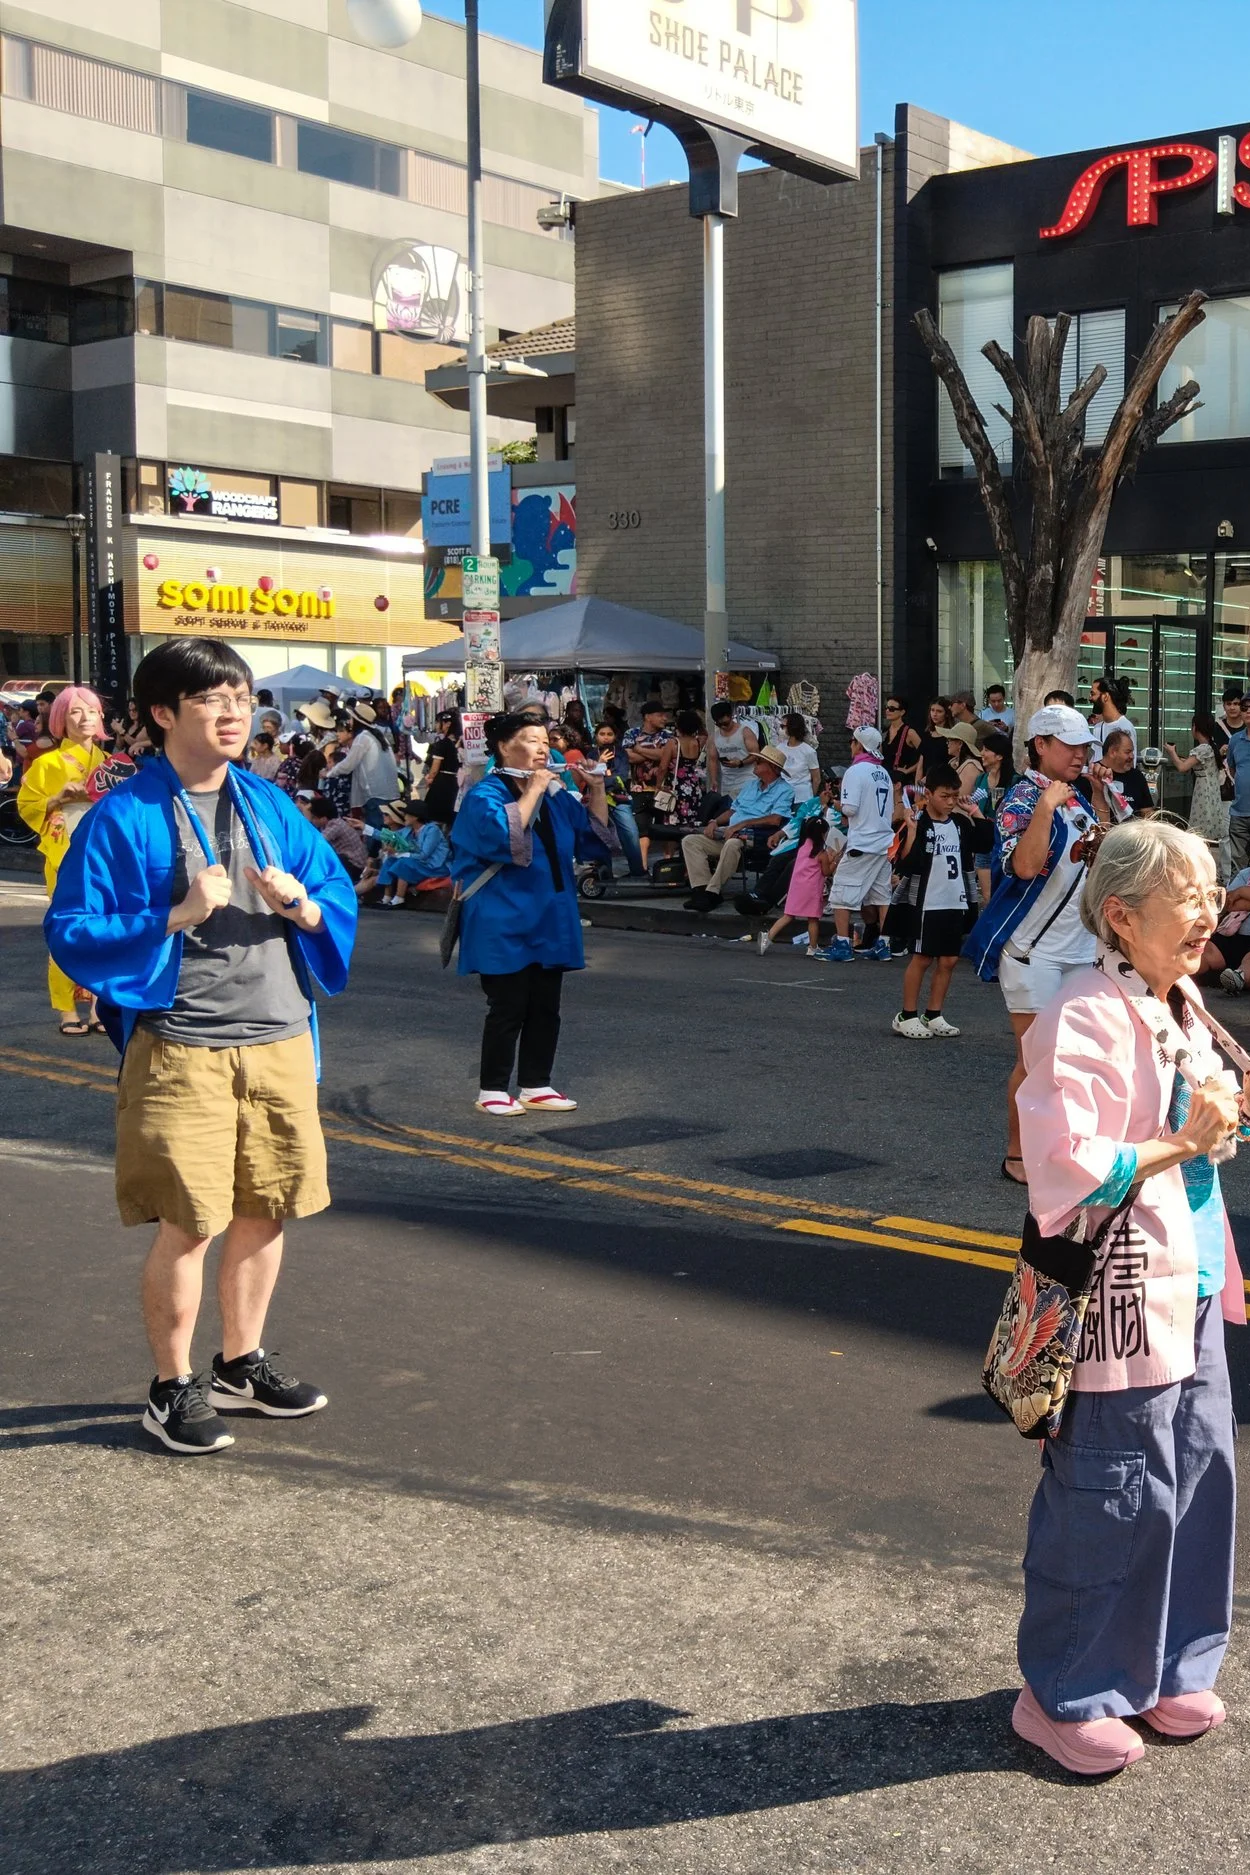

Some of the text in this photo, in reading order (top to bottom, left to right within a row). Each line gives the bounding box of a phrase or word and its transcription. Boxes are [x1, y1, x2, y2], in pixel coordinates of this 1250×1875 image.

[650, 10, 708, 67] SHOE
[719, 39, 803, 106] PALACE
[105, 472, 113, 528] FRANCES
[211, 490, 278, 507] WOODCRAFT
[431, 499, 460, 516] PCRE
[211, 501, 278, 520] RANGERS
[608, 510, 641, 530] 330
[466, 558, 474, 571] 2
[107, 553, 116, 624] HASHIMOTO
[464, 574, 497, 585] PARKING
[466, 727, 480, 740] NO
[871, 770, 890, 784] OHTAN
[876, 787, 889, 817] 17
[935, 834, 945, 842] OS
[946, 855, 959, 880] 3
